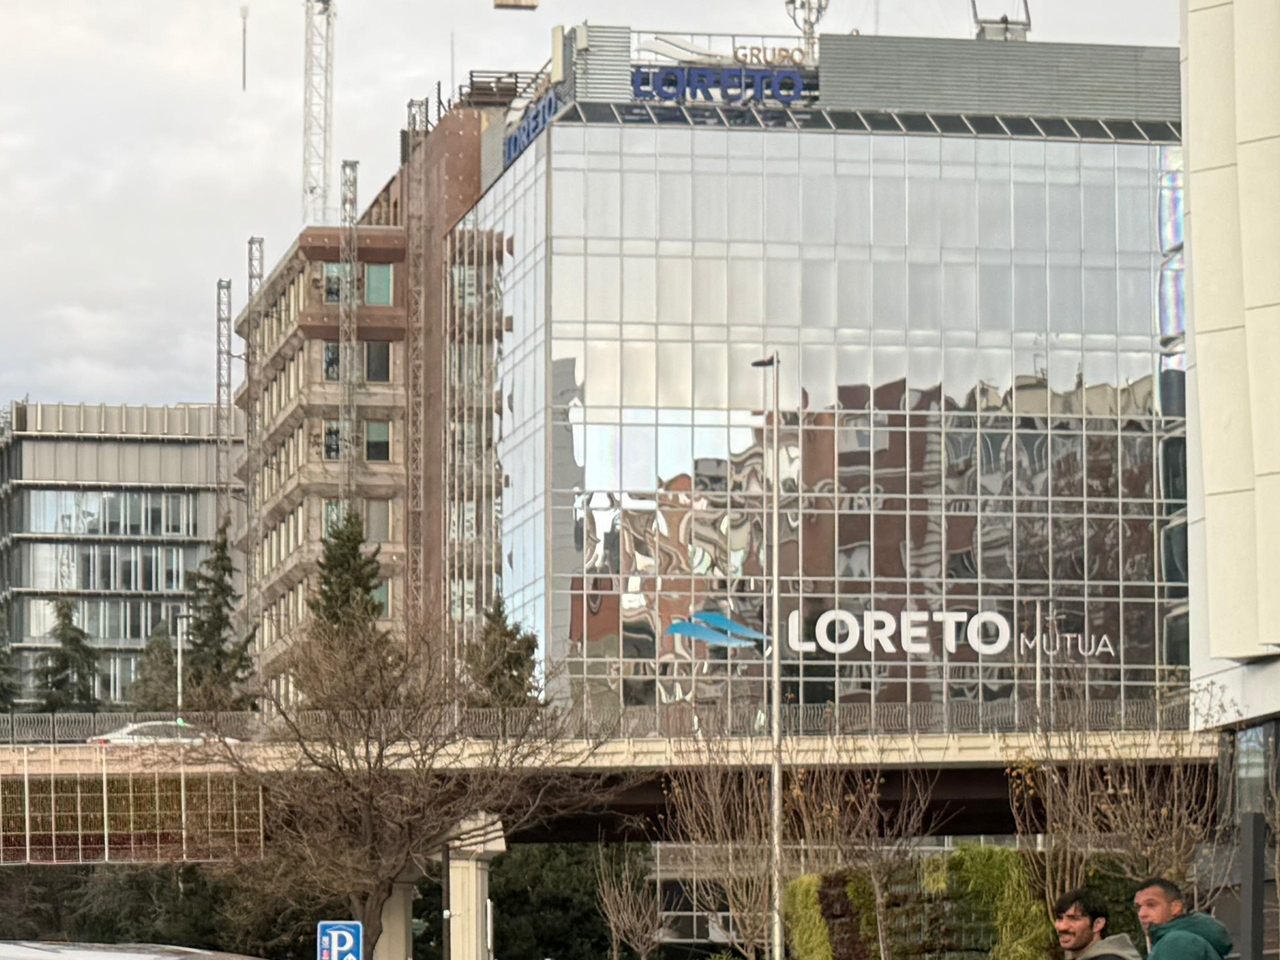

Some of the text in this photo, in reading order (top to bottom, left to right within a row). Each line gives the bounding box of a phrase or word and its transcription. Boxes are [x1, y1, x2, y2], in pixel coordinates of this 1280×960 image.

[734, 46, 805, 65] GRUPO
[633, 67, 803, 103] LORETO
[788, 609, 1115, 657] LORETO MUTUA
